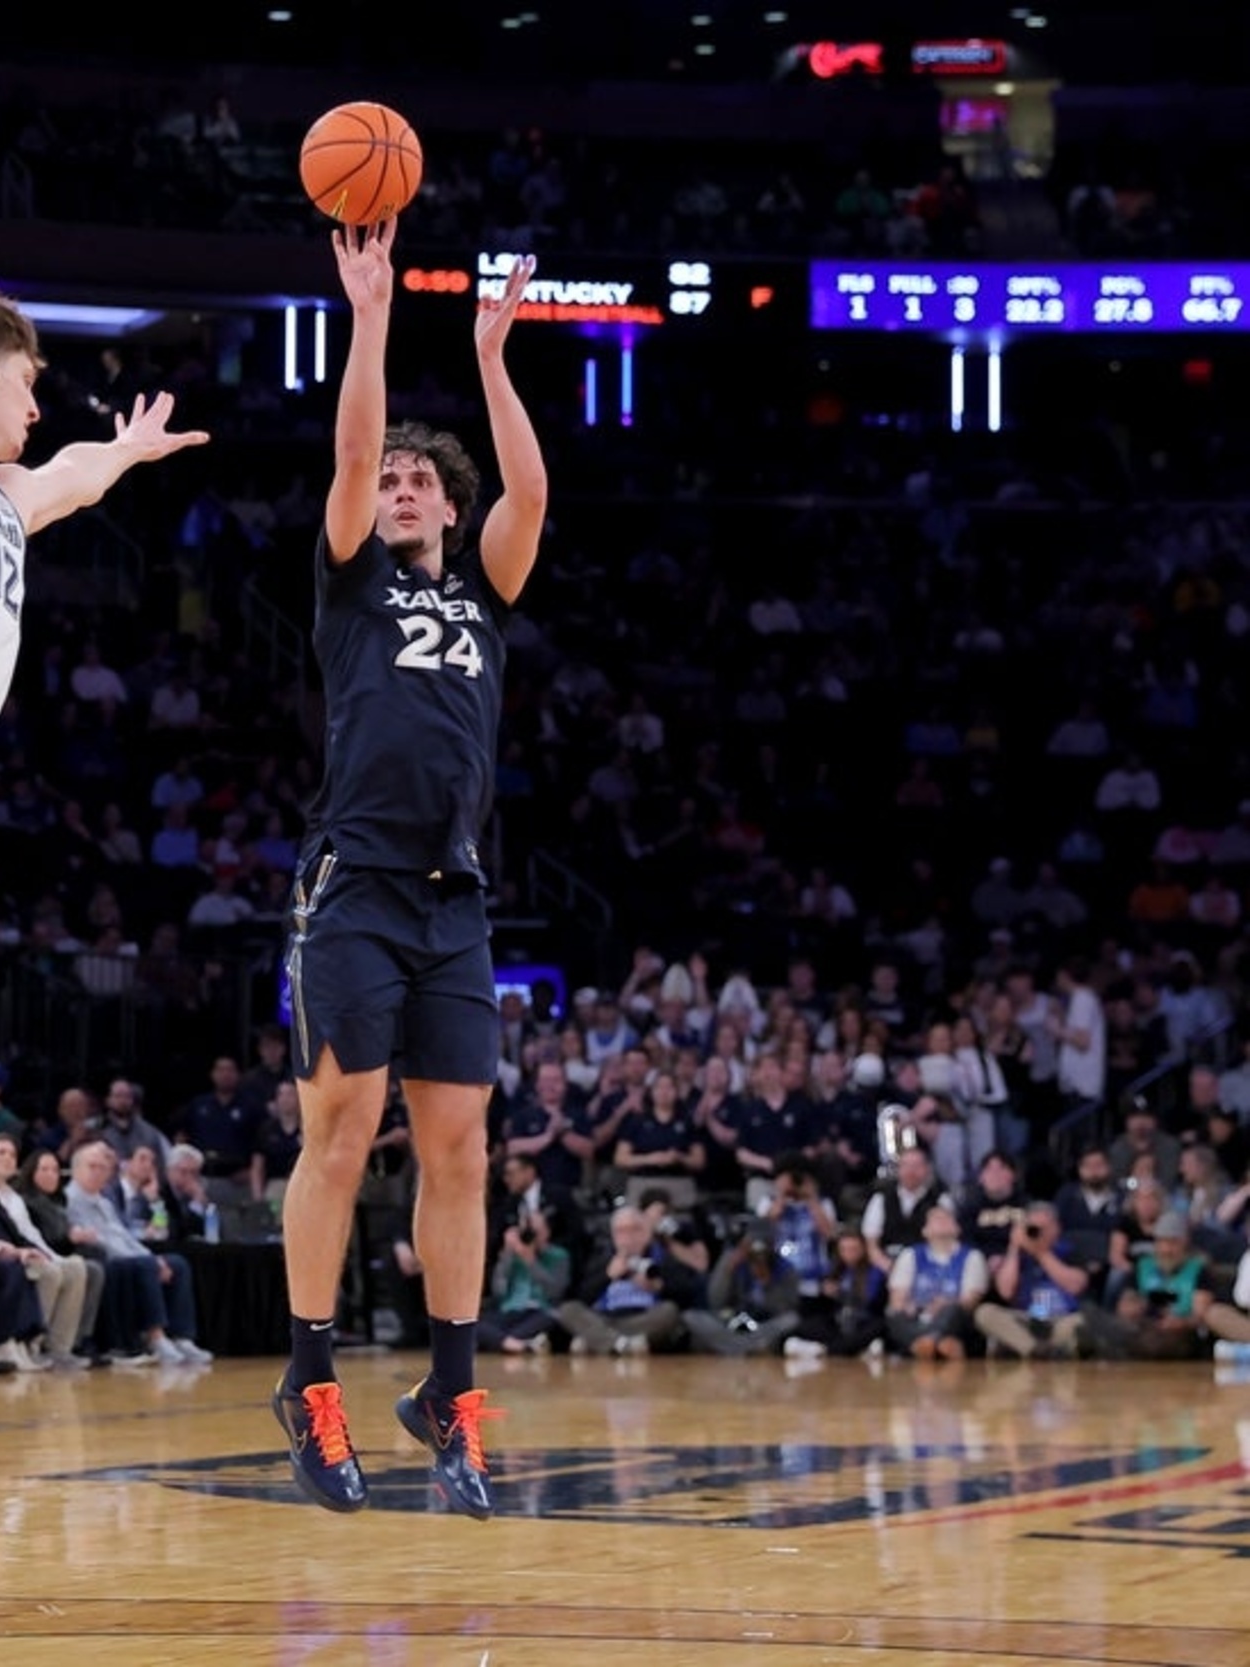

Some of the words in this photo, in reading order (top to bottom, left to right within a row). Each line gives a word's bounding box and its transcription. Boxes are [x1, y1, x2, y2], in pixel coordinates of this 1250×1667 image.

[849, 295, 867, 319] 1
[904, 296, 922, 320] 1
[394, 614, 484, 678] 24
